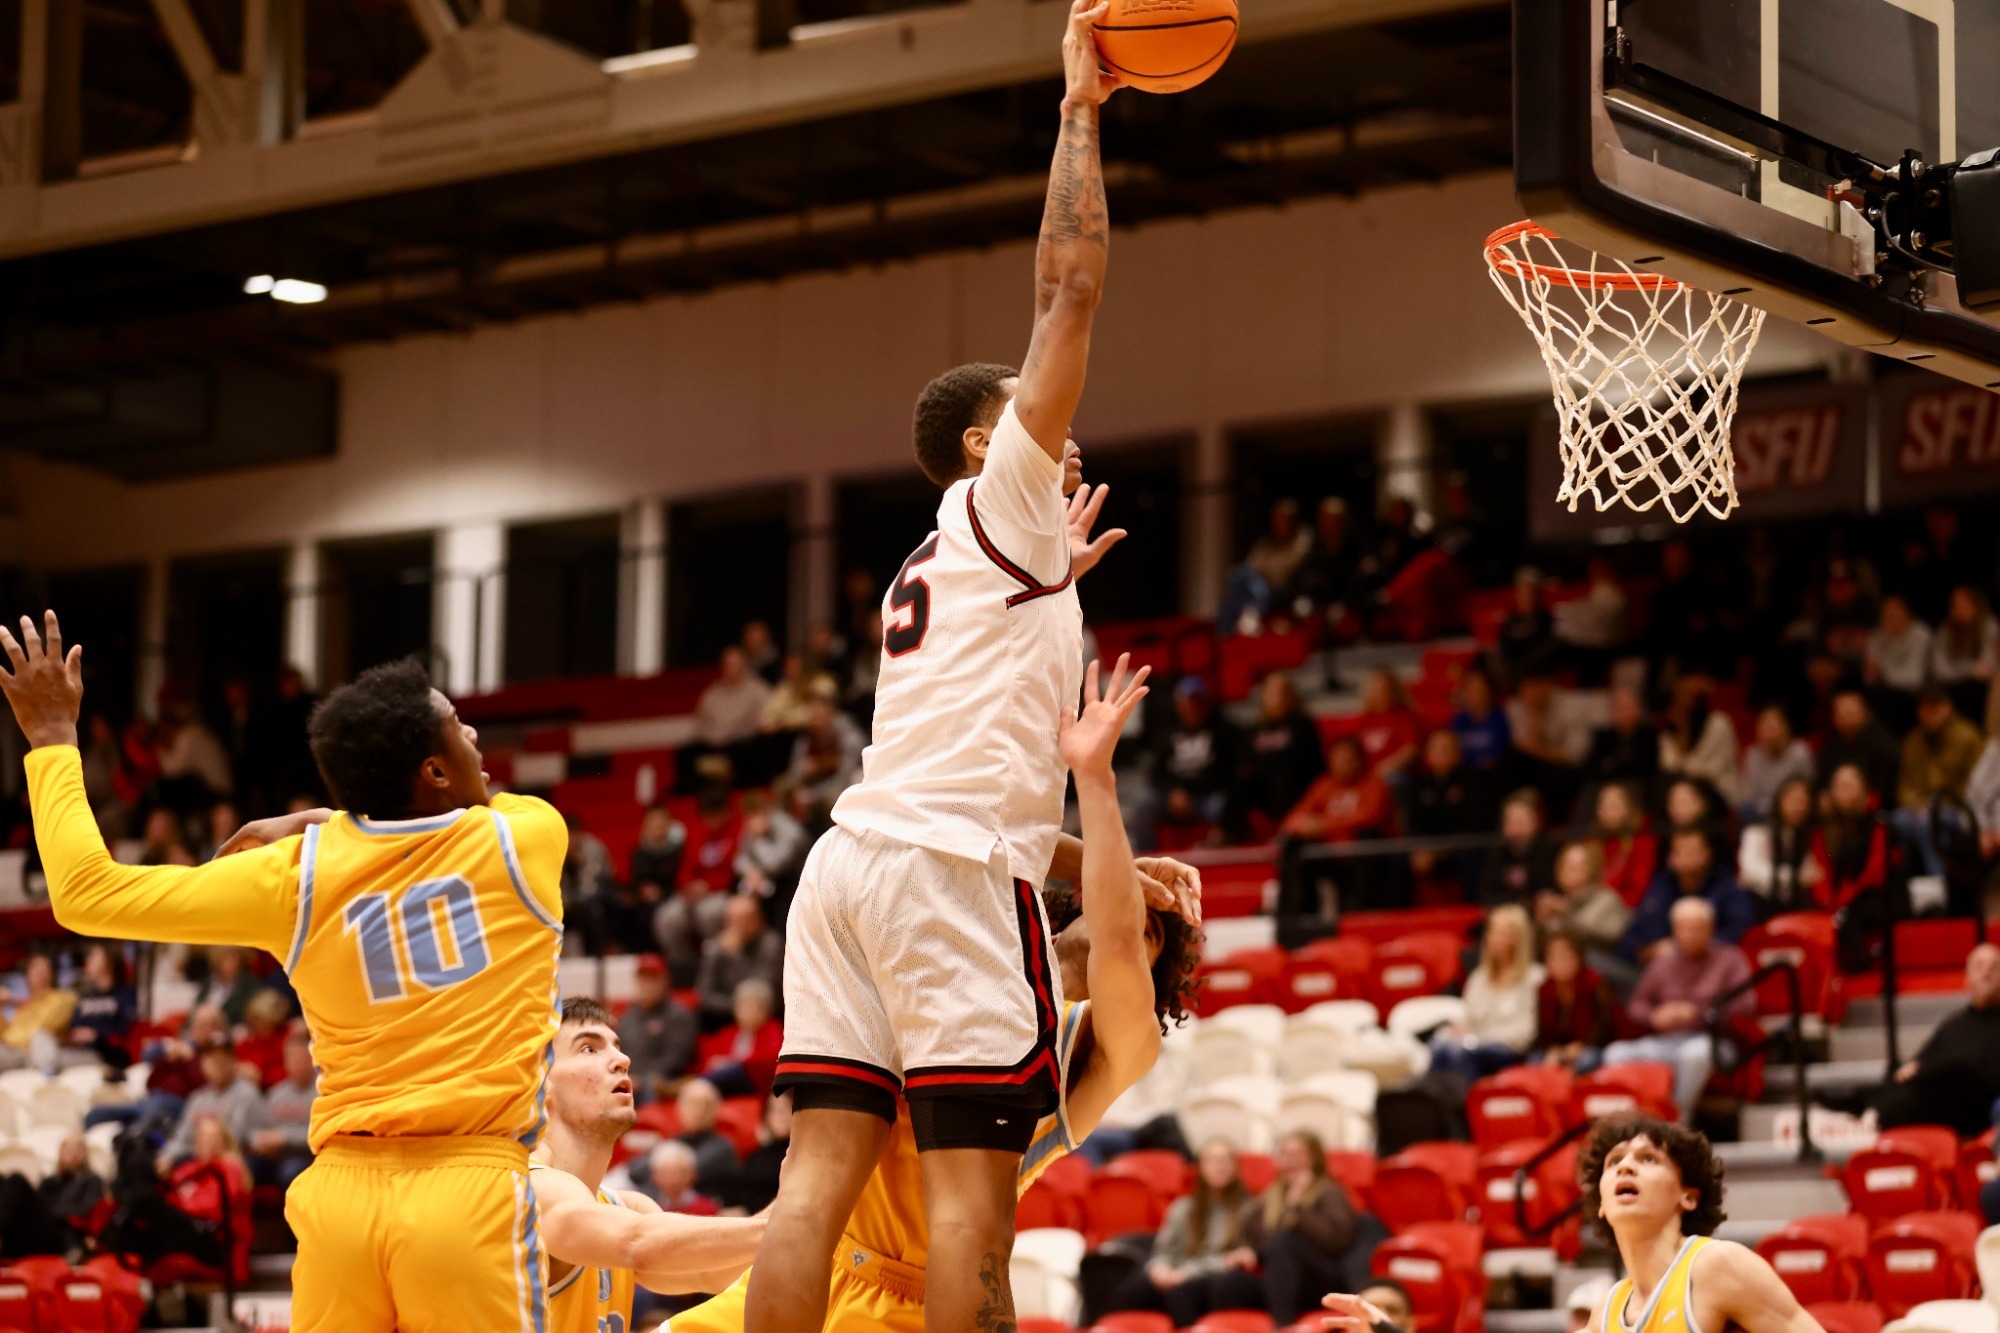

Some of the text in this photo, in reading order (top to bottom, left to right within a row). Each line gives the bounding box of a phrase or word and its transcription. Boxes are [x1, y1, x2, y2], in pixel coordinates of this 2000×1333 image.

[1733, 405, 1840, 488] SFU
[884, 532, 941, 658] 5
[342, 872, 493, 1006] 10
